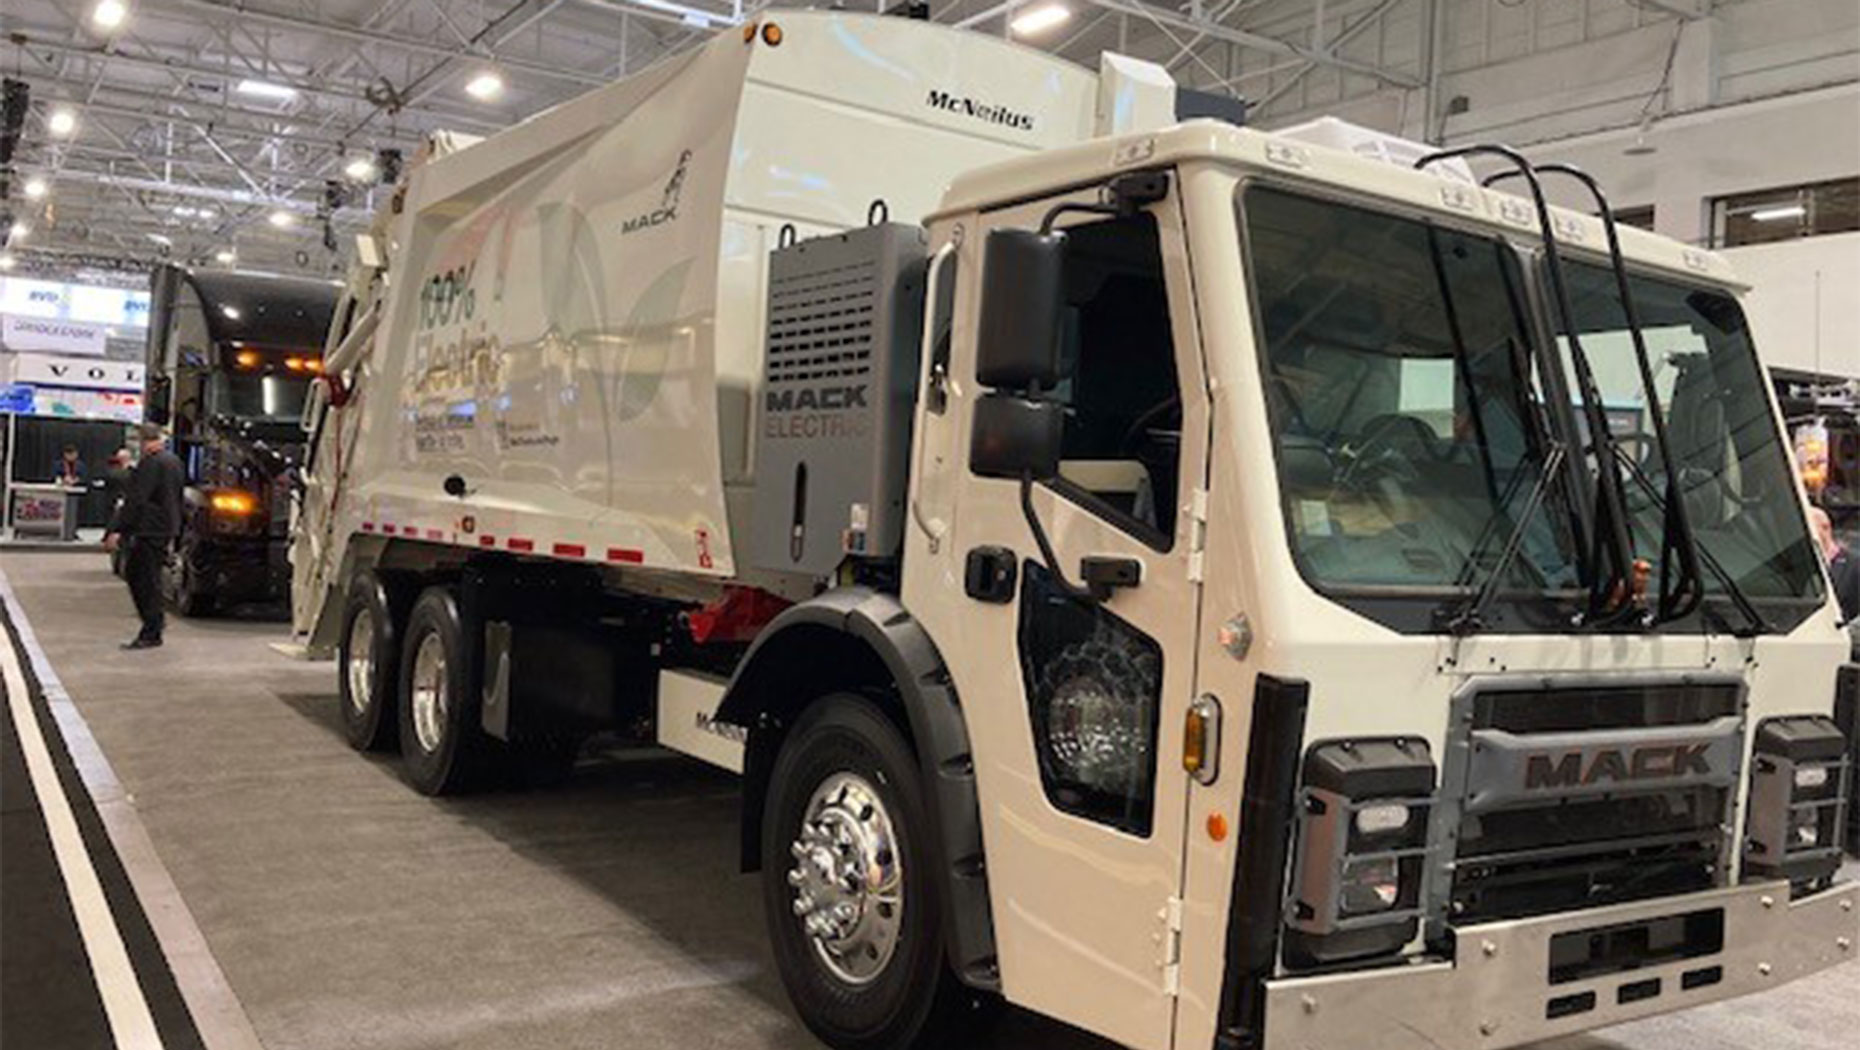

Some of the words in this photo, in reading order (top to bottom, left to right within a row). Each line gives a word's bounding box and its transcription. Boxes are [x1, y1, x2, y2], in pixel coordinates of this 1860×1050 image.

[926, 89, 1034, 130] McNeilus
[622, 205, 677, 234] MACK
[420, 260, 477, 330] 100%
[766, 384, 868, 411] MACK
[1526, 743, 1711, 788] MACK
